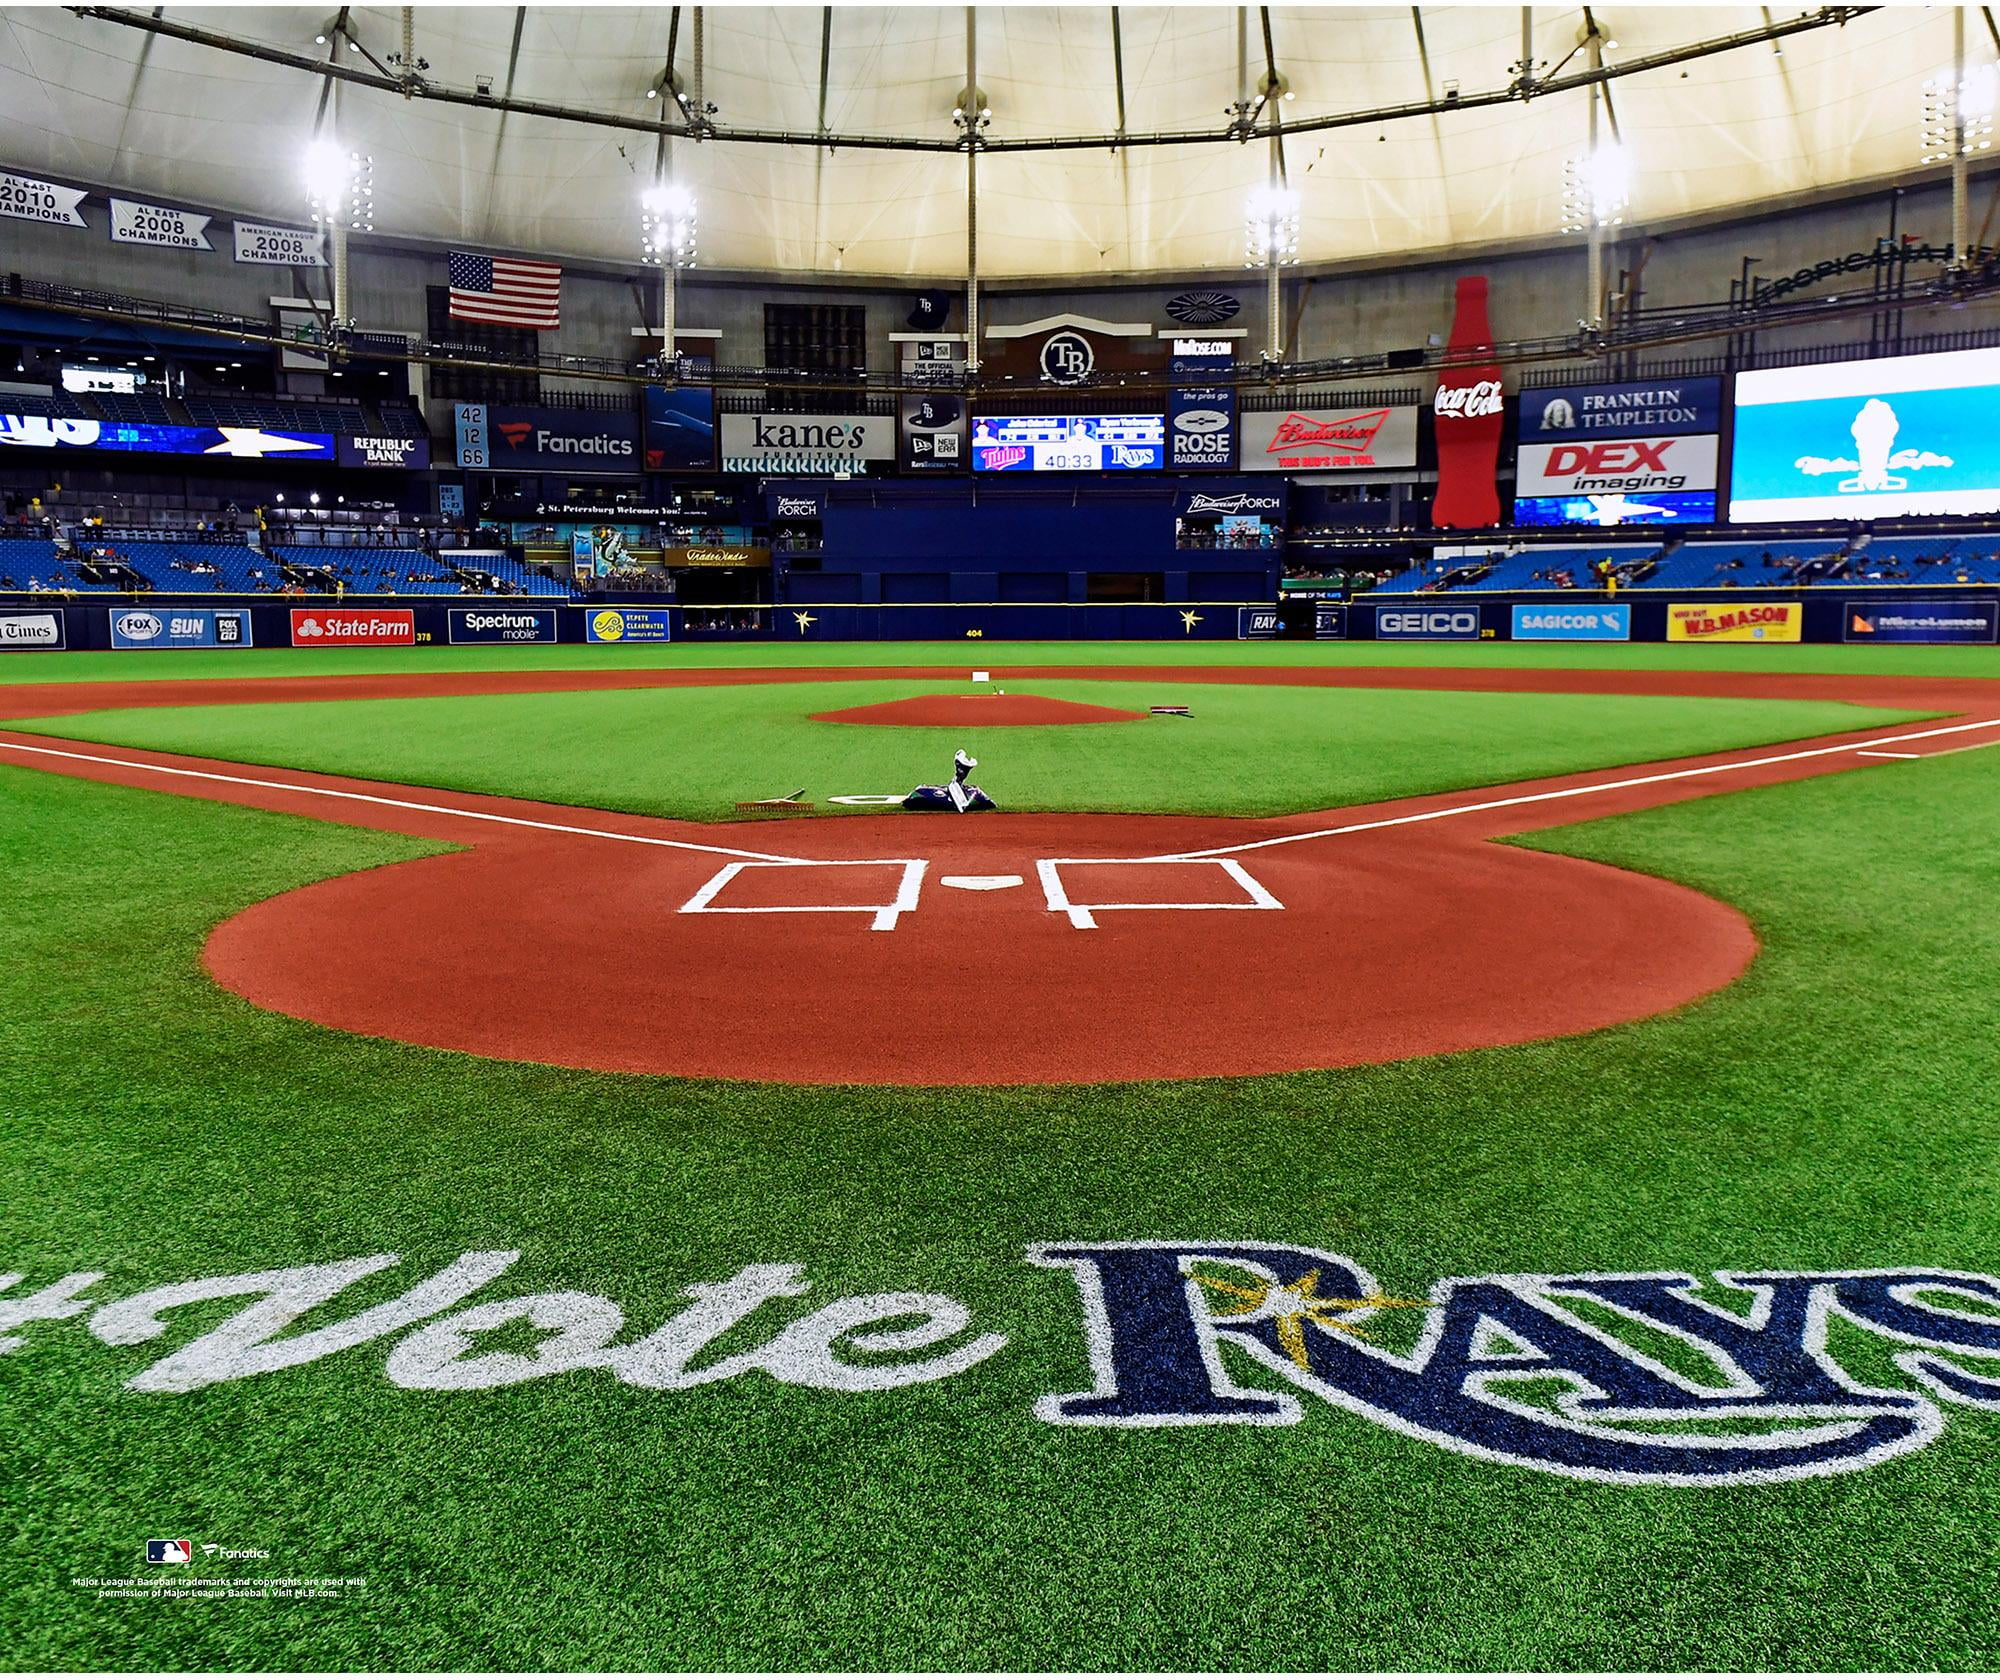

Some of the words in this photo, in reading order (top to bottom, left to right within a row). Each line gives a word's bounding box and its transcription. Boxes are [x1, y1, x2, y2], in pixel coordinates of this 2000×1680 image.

[4, 177, 18, 187] AL
[23, 181, 52, 192] EAST
[0, 186, 55, 209] 2010
[0, 201, 70, 222] AMPIONS
[138, 207, 150, 215] AL
[155, 210, 180, 219] EAST
[134, 215, 184, 234] 2008
[120, 228, 198, 247] CHAMPIONS
[241, 228, 282, 237] AMERICAN
[284, 231, 314, 240] LEAGUE
[256, 237, 303, 254] 2008
[242, 249, 316, 264] CHAMPIONS
[920, 298, 932, 313] TB
[1051, 343, 1085, 375] TB
[1198, 394, 1216, 402] pros
[1218, 393, 1228, 402] go
[1583, 390, 1680, 410] FRANKLIN
[461, 408, 482, 423] 42
[922, 403, 933, 418] TB
[1581, 407, 1698, 428] TEMPLETON
[464, 428, 480, 444] 12
[752, 416, 866, 449] kane's
[1278, 424, 1377, 443] Budweiser
[354, 437, 415, 451] REPUBLIC
[537, 430, 632, 455] Fanatics
[1174, 434, 1230, 453] ROSE
[367, 450, 404, 462] BANK
[463, 449, 482, 464] 66
[980, 446, 1026, 470] Twins
[1045, 455, 1092, 468] 40:33
[1174, 454, 1229, 464] RADIOLOGY
[1544, 440, 1677, 478] DEX
[1573, 474, 1687, 491] imaging
[548, 504, 560, 512] St.
[563, 505, 614, 515] Petersburg
[617, 506, 659, 514] Welcomes
[662, 507, 681, 515] You!
[1194, 498, 1241, 508] Budweiser
[1240, 498, 1280, 508] PORCH
[778, 506, 816, 516] PORCH
[127, 619, 152, 630] FOX
[170, 618, 204, 634] SUN
[219, 620, 237, 629] FOX
[466, 613, 535, 631] Spectrum
[1380, 614, 1476, 632] GEICO
[1522, 615, 1598, 630] SAGICOR
[6, 623, 50, 638] Times
[220, 632, 238, 640] GO
